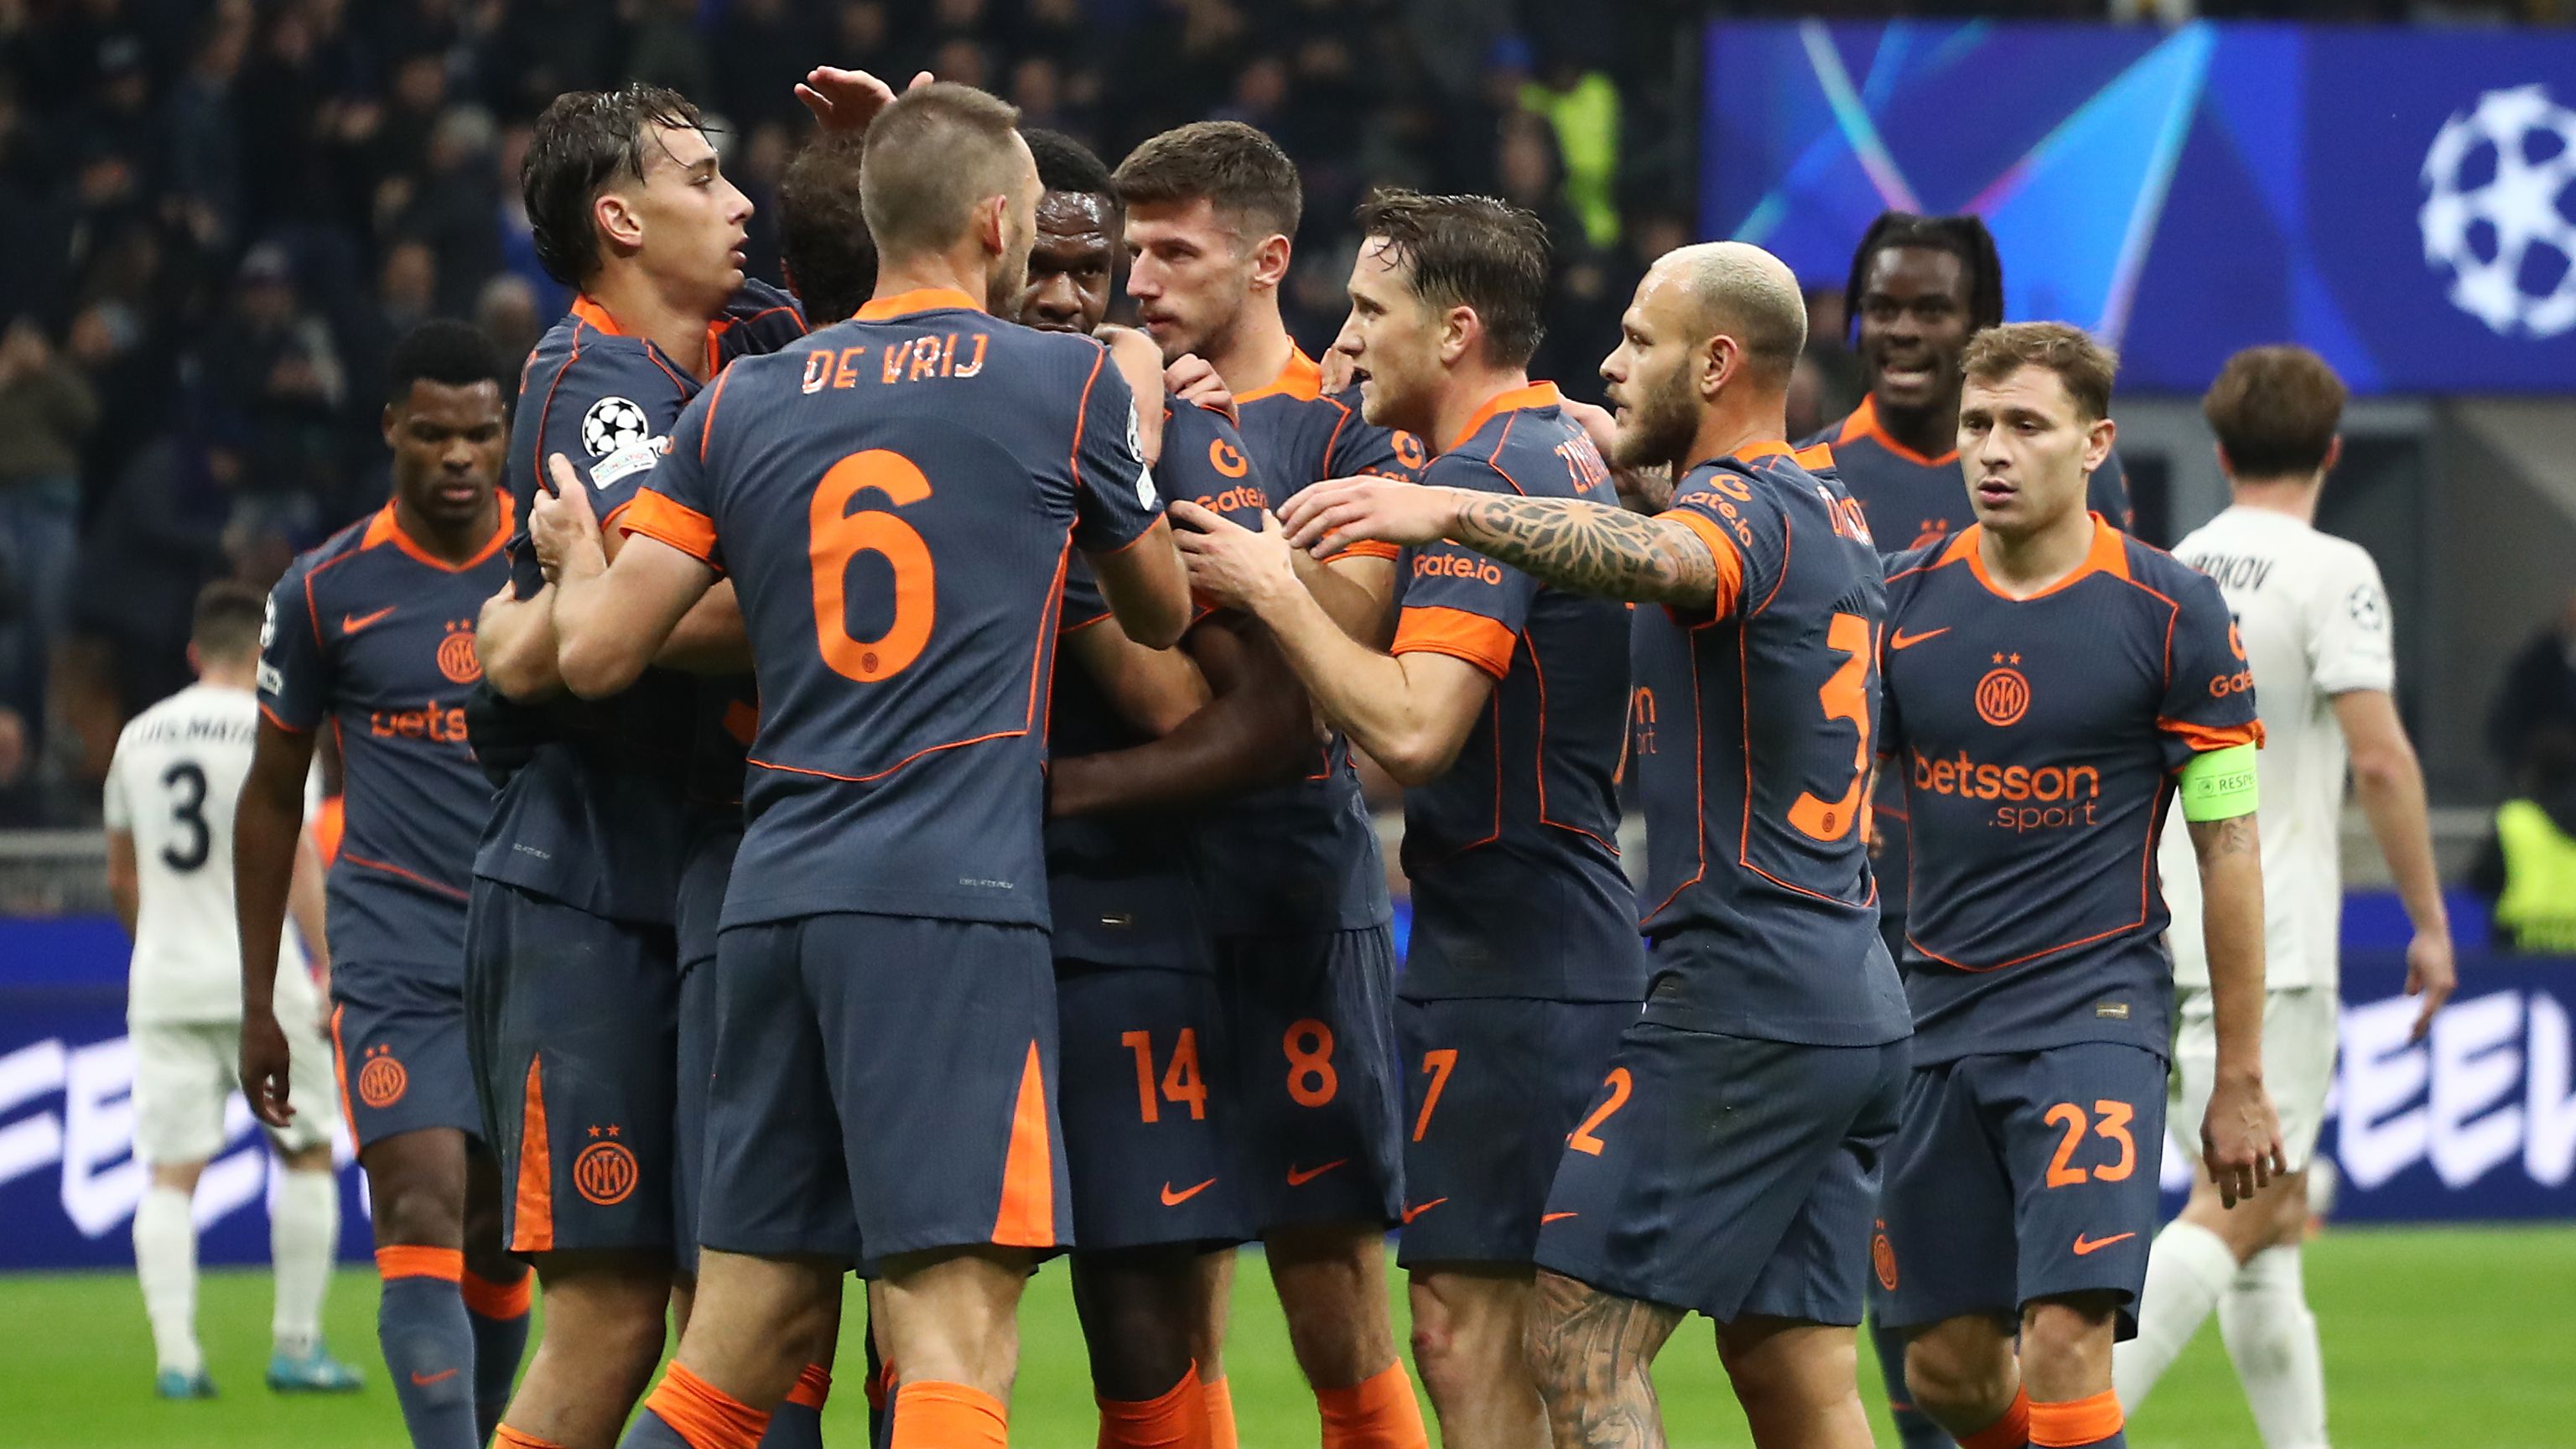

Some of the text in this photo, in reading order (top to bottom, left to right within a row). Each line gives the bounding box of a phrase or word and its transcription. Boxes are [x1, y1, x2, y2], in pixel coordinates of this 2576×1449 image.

[802, 334, 989, 394] DE VRIJ
[808, 448, 937, 683] 6
[1786, 612, 1873, 844] 3
[162, 759, 210, 872] 3
[1913, 747, 2101, 802] betsson
[1987, 799, 2100, 834] .sport
[1121, 1027, 1208, 1124] 14
[1282, 1018, 1338, 1108] 8
[1412, 1048, 1458, 1142] 7
[1566, 1067, 1633, 1156] 2
[2044, 1099, 2137, 1188] 23
